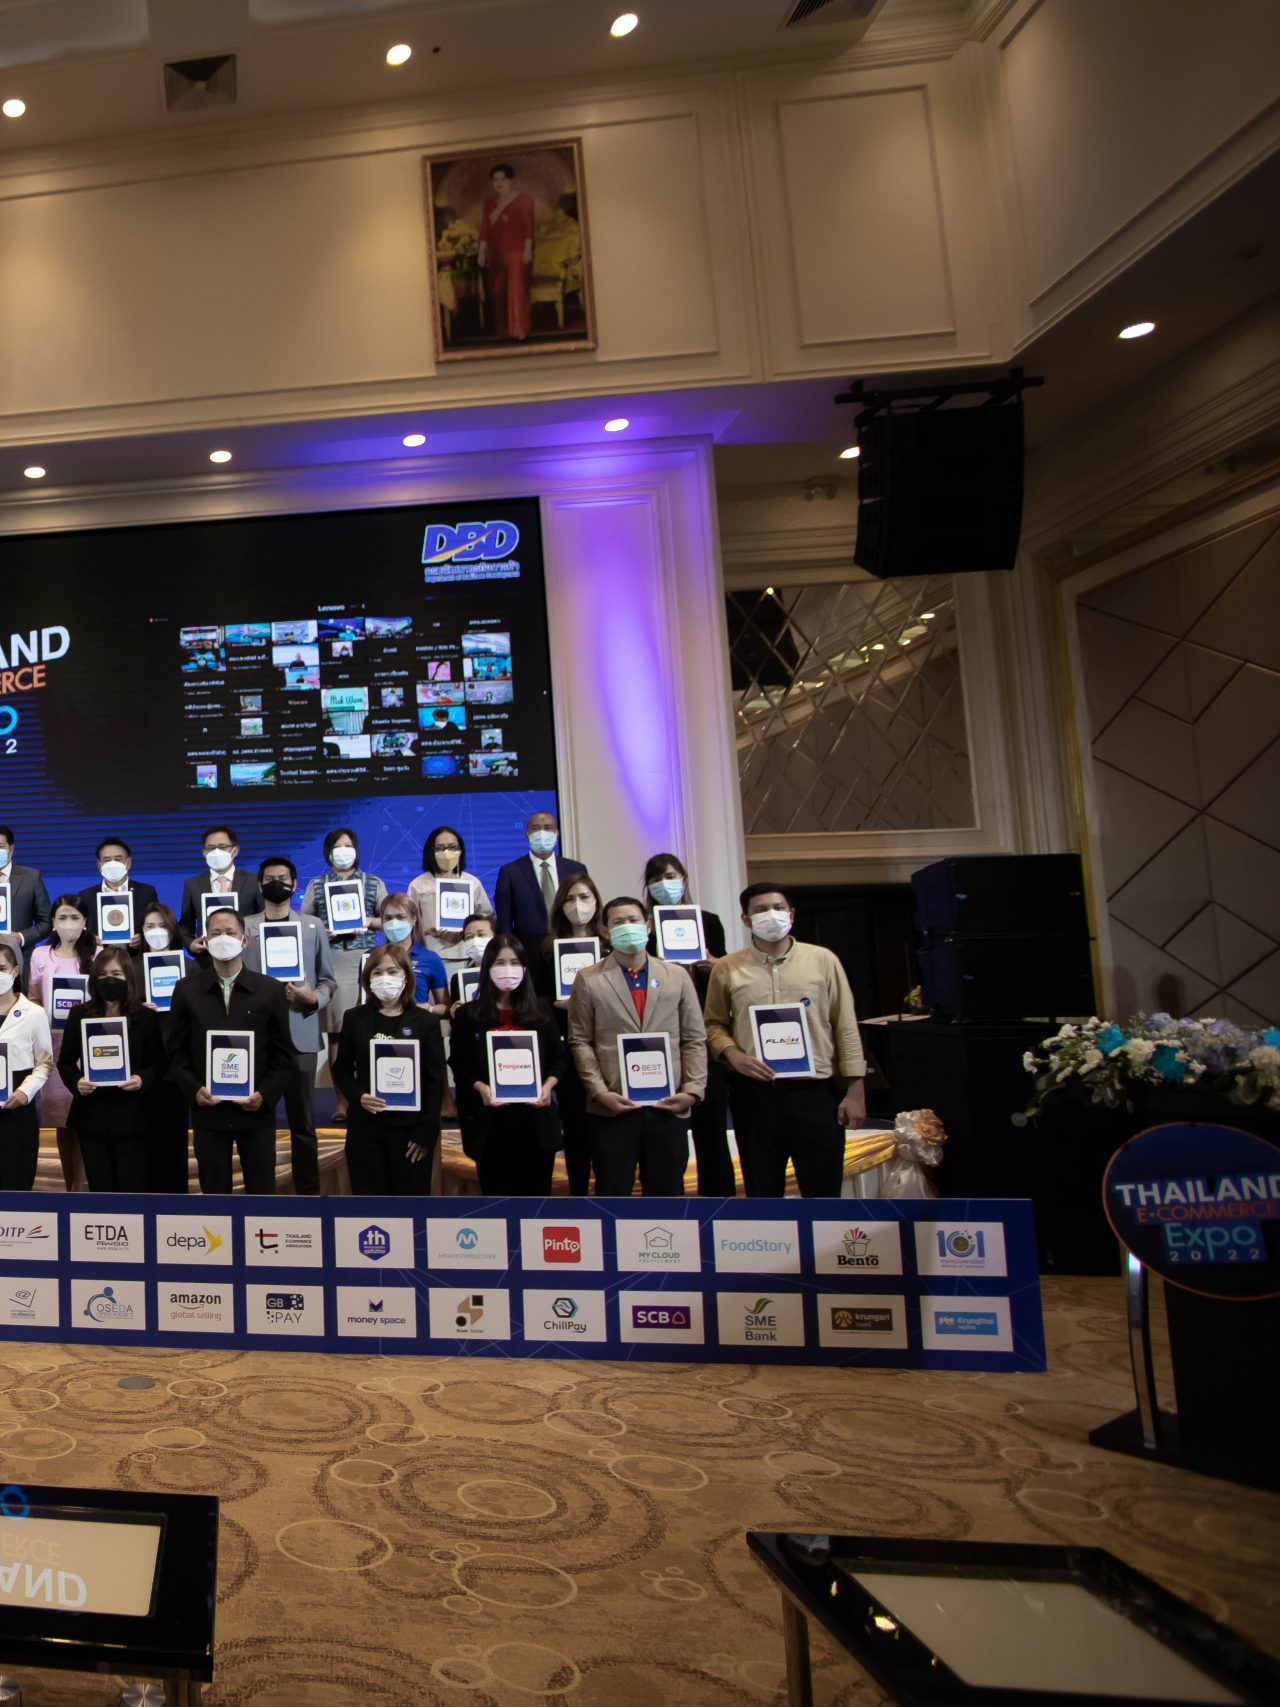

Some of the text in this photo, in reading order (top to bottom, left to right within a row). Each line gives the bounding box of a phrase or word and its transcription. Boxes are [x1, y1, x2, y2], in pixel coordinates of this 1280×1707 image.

[421, 520, 519, 563] DBD
[84, 1225, 129, 1241] ETDA
[363, 1231, 385, 1245] .th
[167, 1232, 206, 1251] depa
[544, 1238, 580, 1253] Pinto
[721, 1239, 791, 1254] FoodStory
[936, 1230, 985, 1257] 101
[1164, 1222, 1257, 1260] Expo
[170, 1293, 221, 1304] amazon
[266, 1298, 284, 1308] GB
[96, 1303, 134, 1313] OSEDA
[170, 1311, 222, 1321] global selling
[275, 1313, 302, 1324] PAY
[347, 1316, 406, 1325] money space
[637, 1311, 669, 1324] SCB
[745, 1315, 776, 1326] SME
[543, 1320, 587, 1333] ChillPay
[745, 1331, 777, 1341] Bank
